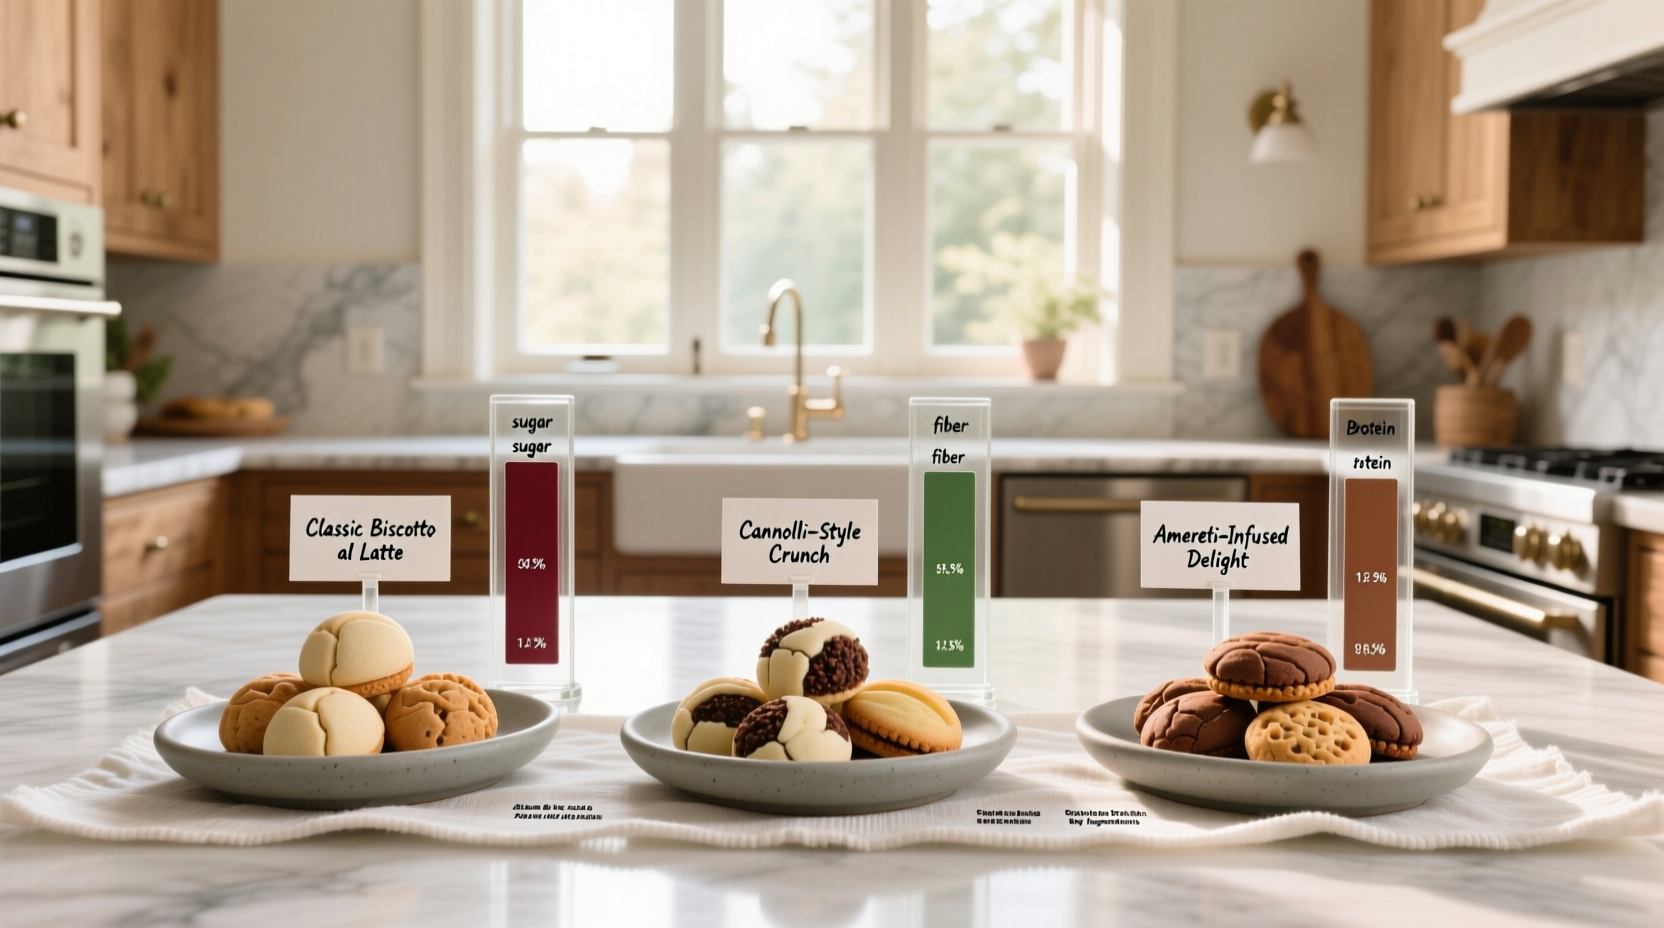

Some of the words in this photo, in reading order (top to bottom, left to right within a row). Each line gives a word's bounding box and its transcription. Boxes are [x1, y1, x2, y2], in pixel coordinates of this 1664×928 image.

[511, 417, 554, 435] sugar
[933, 414, 970, 435] fiber
[931, 448, 966, 465] fiber
[305, 517, 363, 538] Classic
[370, 518, 437, 538] Biscotto
[739, 519, 862, 548] Cannolli-Style
[1152, 523, 1290, 550] Amereti-Infused
[337, 542, 355, 561] al
[359, 542, 404, 561] Latte
[769, 543, 830, 564] Crunch
[1186, 548, 1250, 576] Delight
